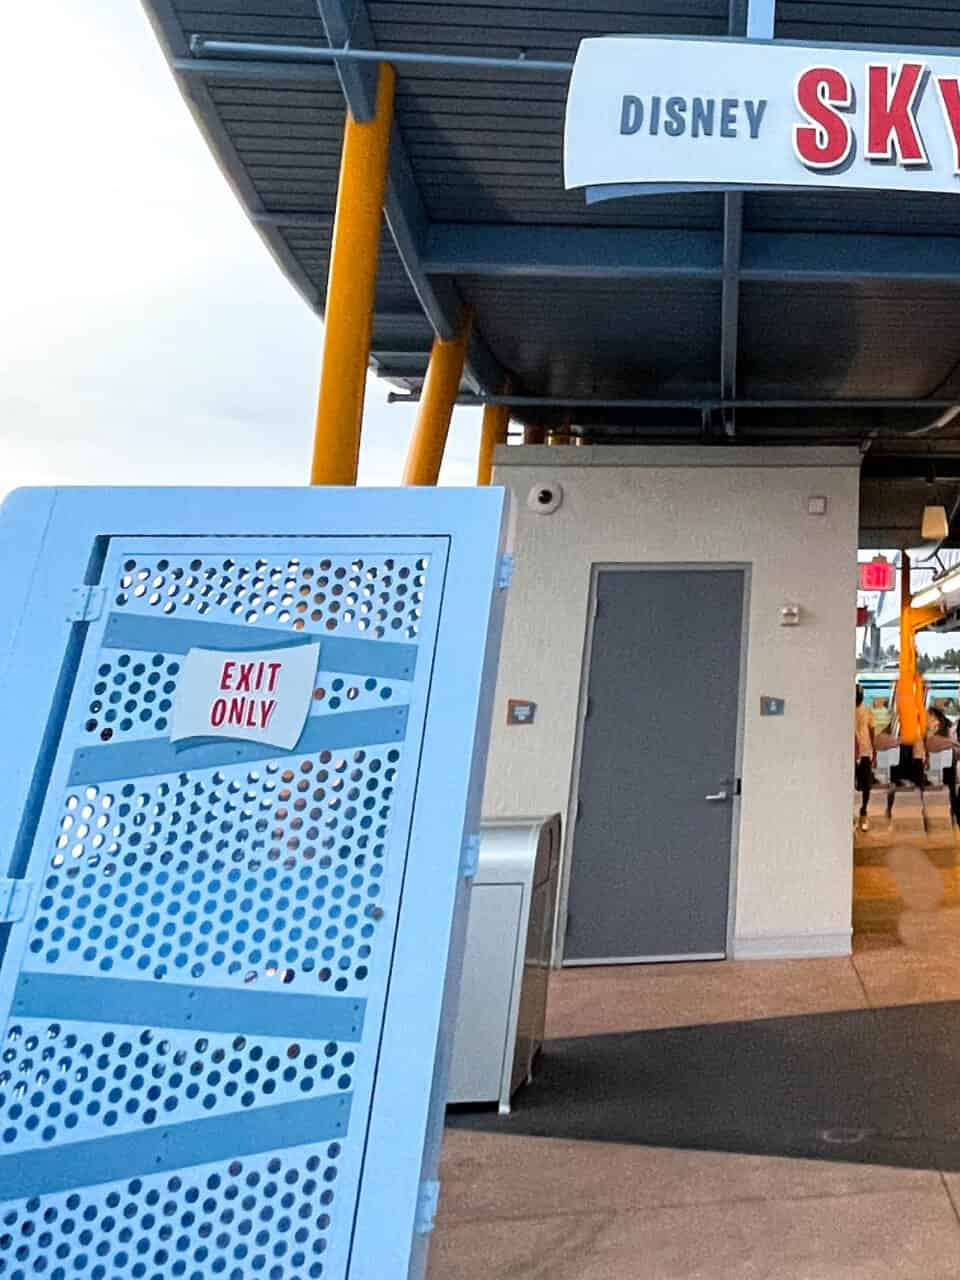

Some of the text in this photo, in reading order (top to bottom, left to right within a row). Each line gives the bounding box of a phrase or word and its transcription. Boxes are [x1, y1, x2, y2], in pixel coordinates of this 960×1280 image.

[620, 95, 768, 139] DISNEY
[219, 661, 282, 691] EXIT
[210, 696, 276, 728] ONLY
